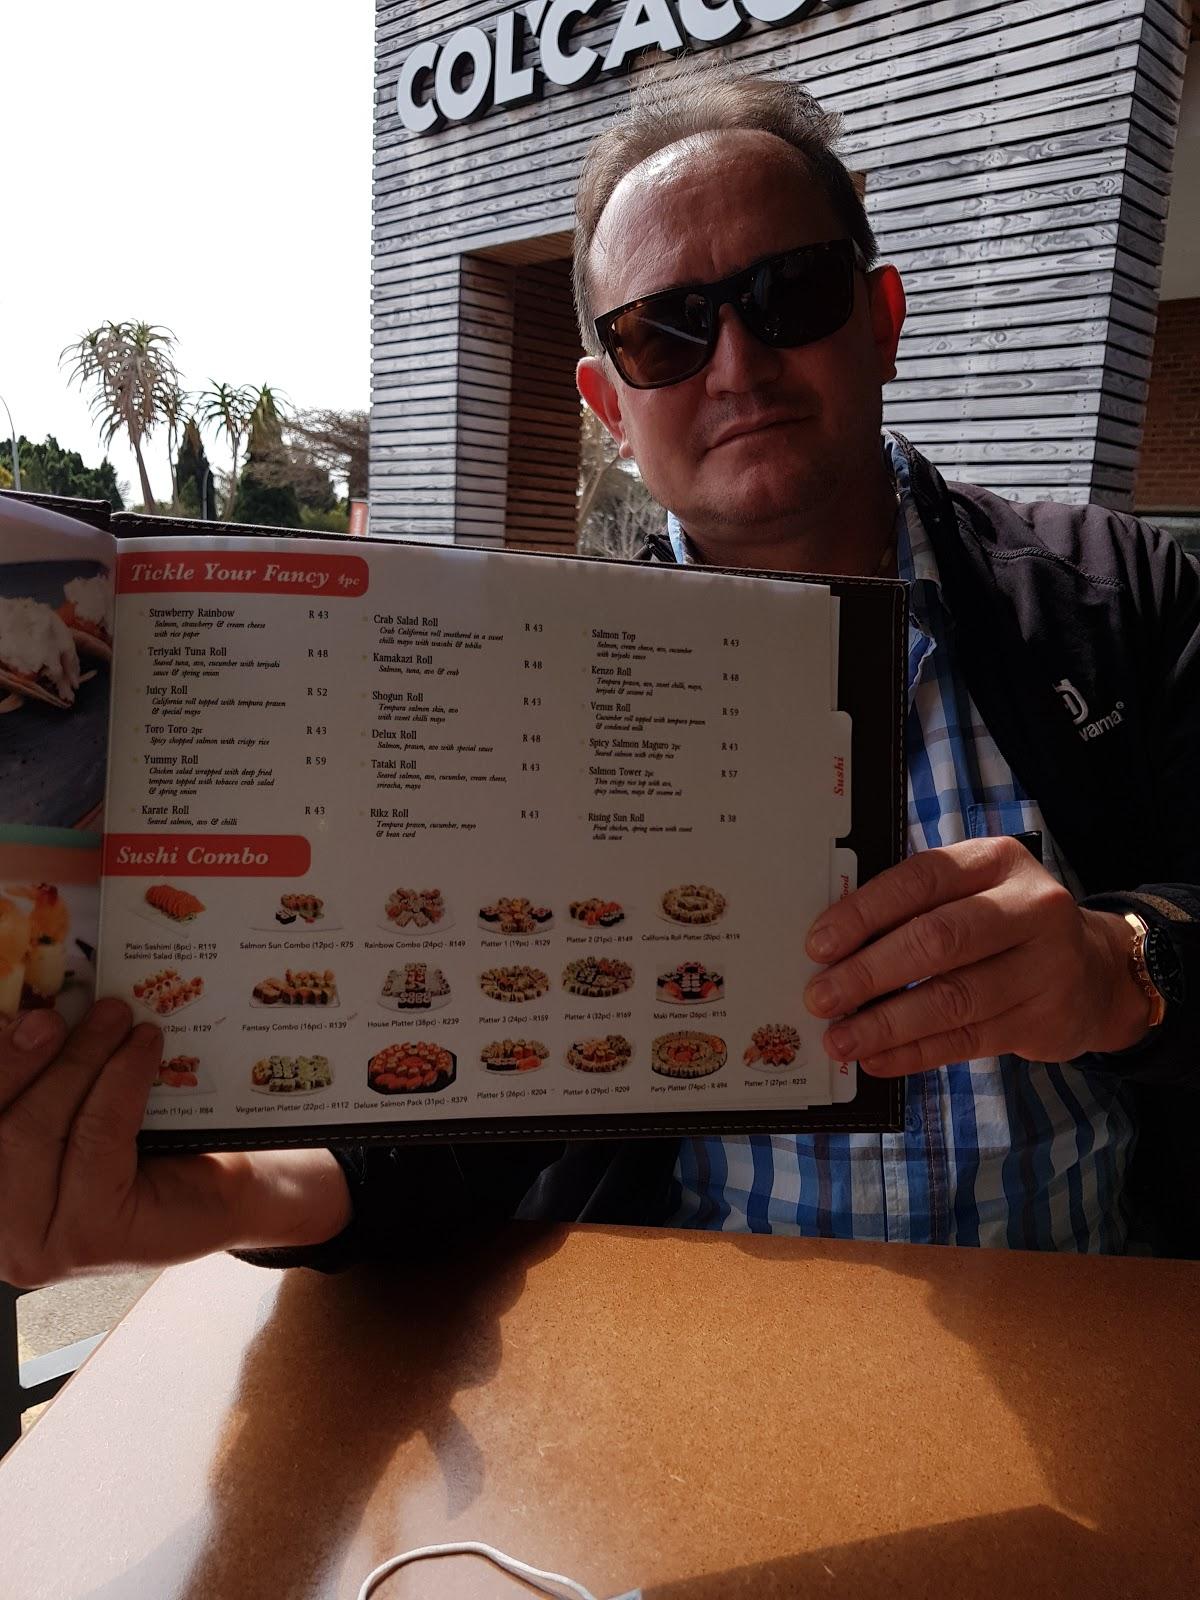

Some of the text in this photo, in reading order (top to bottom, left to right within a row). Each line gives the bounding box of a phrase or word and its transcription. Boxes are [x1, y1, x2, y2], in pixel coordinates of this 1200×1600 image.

[397, 0, 808, 133] COL'CA
[131, 564, 194, 581] Tickle
[204, 563, 256, 581] Your
[264, 565, 329, 588] Fancy
[149, 608, 234, 619] Strawberry Rainbow
[309, 610, 328, 619] R 43
[374, 615, 438, 626] Crab Salad Roll
[533, 624, 542, 632] 43
[592, 629, 635, 642] Salmon Top
[724, 638, 728, 646] R
[148, 647, 226, 657] Teriyaki Tuna Roll
[309, 649, 313, 657] R
[374, 653, 432, 664] Kamakazi Roll
[525, 660, 542, 669] R 48
[592, 666, 631, 676] Kenzo Roll
[147, 685, 187, 696] Juicy Roll
[317, 688, 327, 696] 52
[373, 691, 423, 703] Shogun Roll
[524, 697, 541, 706] R 43
[591, 702, 630, 712] Venus Roll
[730, 708, 739, 716] 59
[145, 725, 164, 733] Toro
[168, 725, 187, 733] Toro
[307, 726, 312, 734] R
[372, 730, 416, 739] Delux Roll
[523, 734, 540, 743] R 48
[590, 738, 609, 748] Spicy
[612, 739, 639, 748] Salmon
[642, 740, 668, 751] Maguro
[144, 755, 198, 766] Yummy Roll
[316, 757, 326, 765] 59
[371, 760, 416, 769] Tataki Roll
[523, 763, 539, 771] R 43
[589, 766, 616, 775] Salmon
[619, 768, 641, 776] Tower
[195, 768, 222, 776] wrapped
[242, 769, 255, 777] deep
[256, 769, 272, 777] fried
[834, 756, 845, 796] Sushi
[176, 777, 196, 786] topped
[142, 805, 189, 814] Karate Roll
[306, 806, 324, 815] R 43
[371, 809, 408, 817] Rikz Roll
[522, 810, 526, 818] R
[589, 813, 644, 823] Rising Sun Roll
[117, 847, 269, 865] Sushi Combo
[312, 942, 334, 950] (12pc)
[423, 941, 443, 949] (24pc)
[124, 952, 151, 960] Sashimi
[175, 953, 192, 961] (8pc)
[163, 1025, 187, 1034] (12pc)
[425, 1098, 445, 1107] (31pc)
